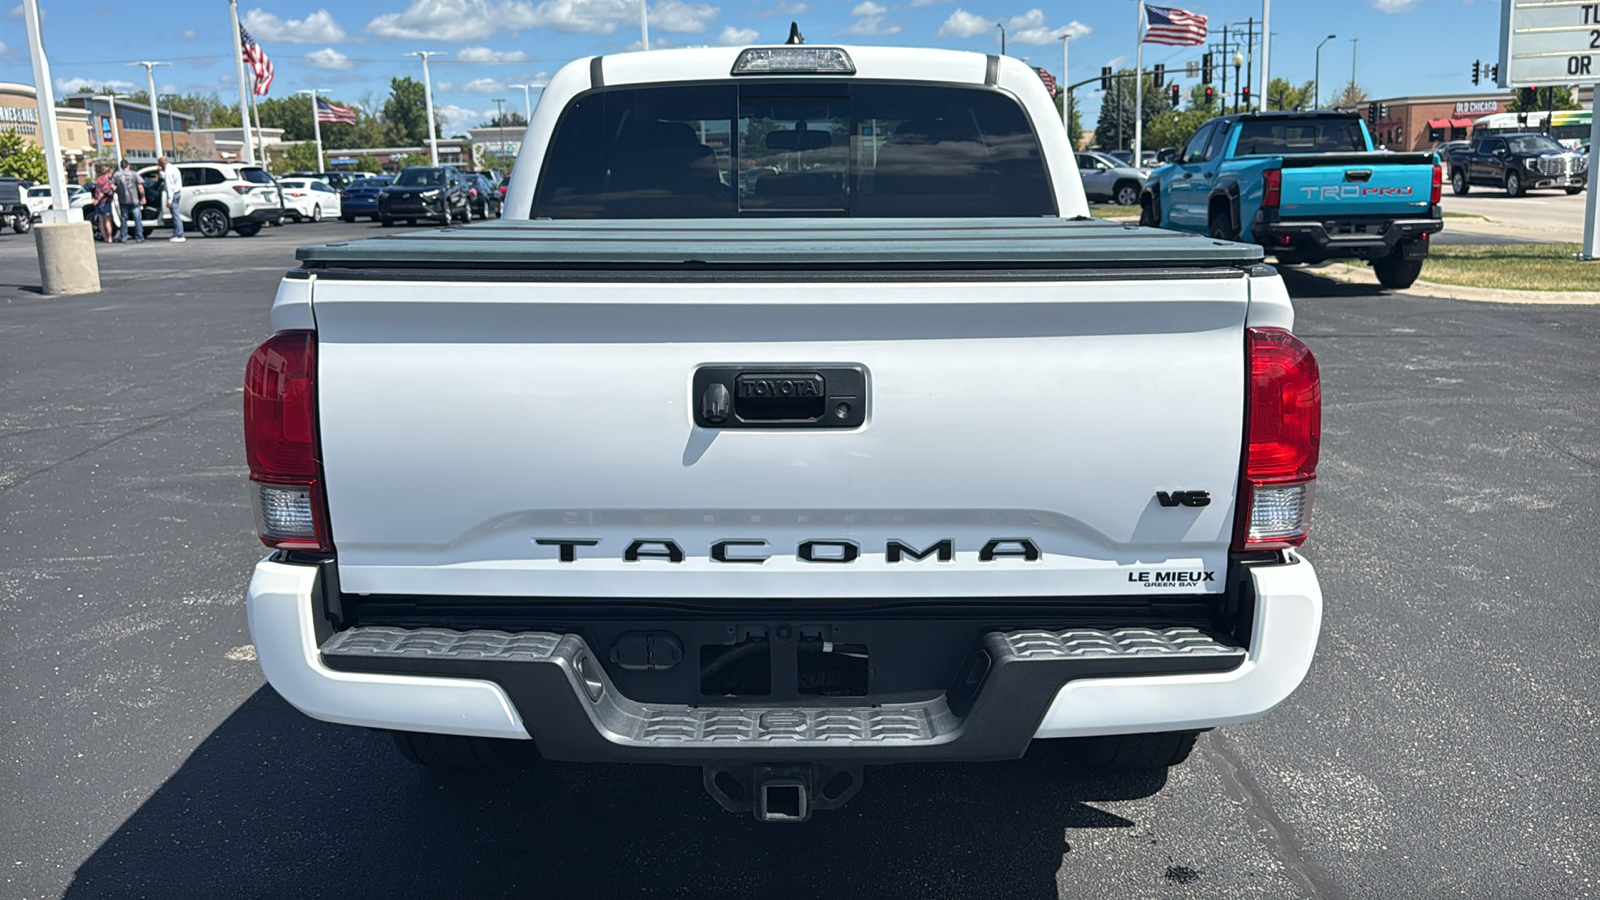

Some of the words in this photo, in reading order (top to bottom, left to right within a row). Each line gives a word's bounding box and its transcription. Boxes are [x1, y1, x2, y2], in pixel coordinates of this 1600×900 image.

[1567, 55, 1592, 75] OR
[1456, 102, 1469, 113] OLD
[1470, 101, 1498, 112] CHICAGO
[743, 380, 819, 397] TOYOTA
[1155, 490, 1211, 508] V6
[534, 537, 1042, 564] TACOMA
[1128, 572, 1150, 582] LE
[1155, 571, 1215, 582] MIEUX
